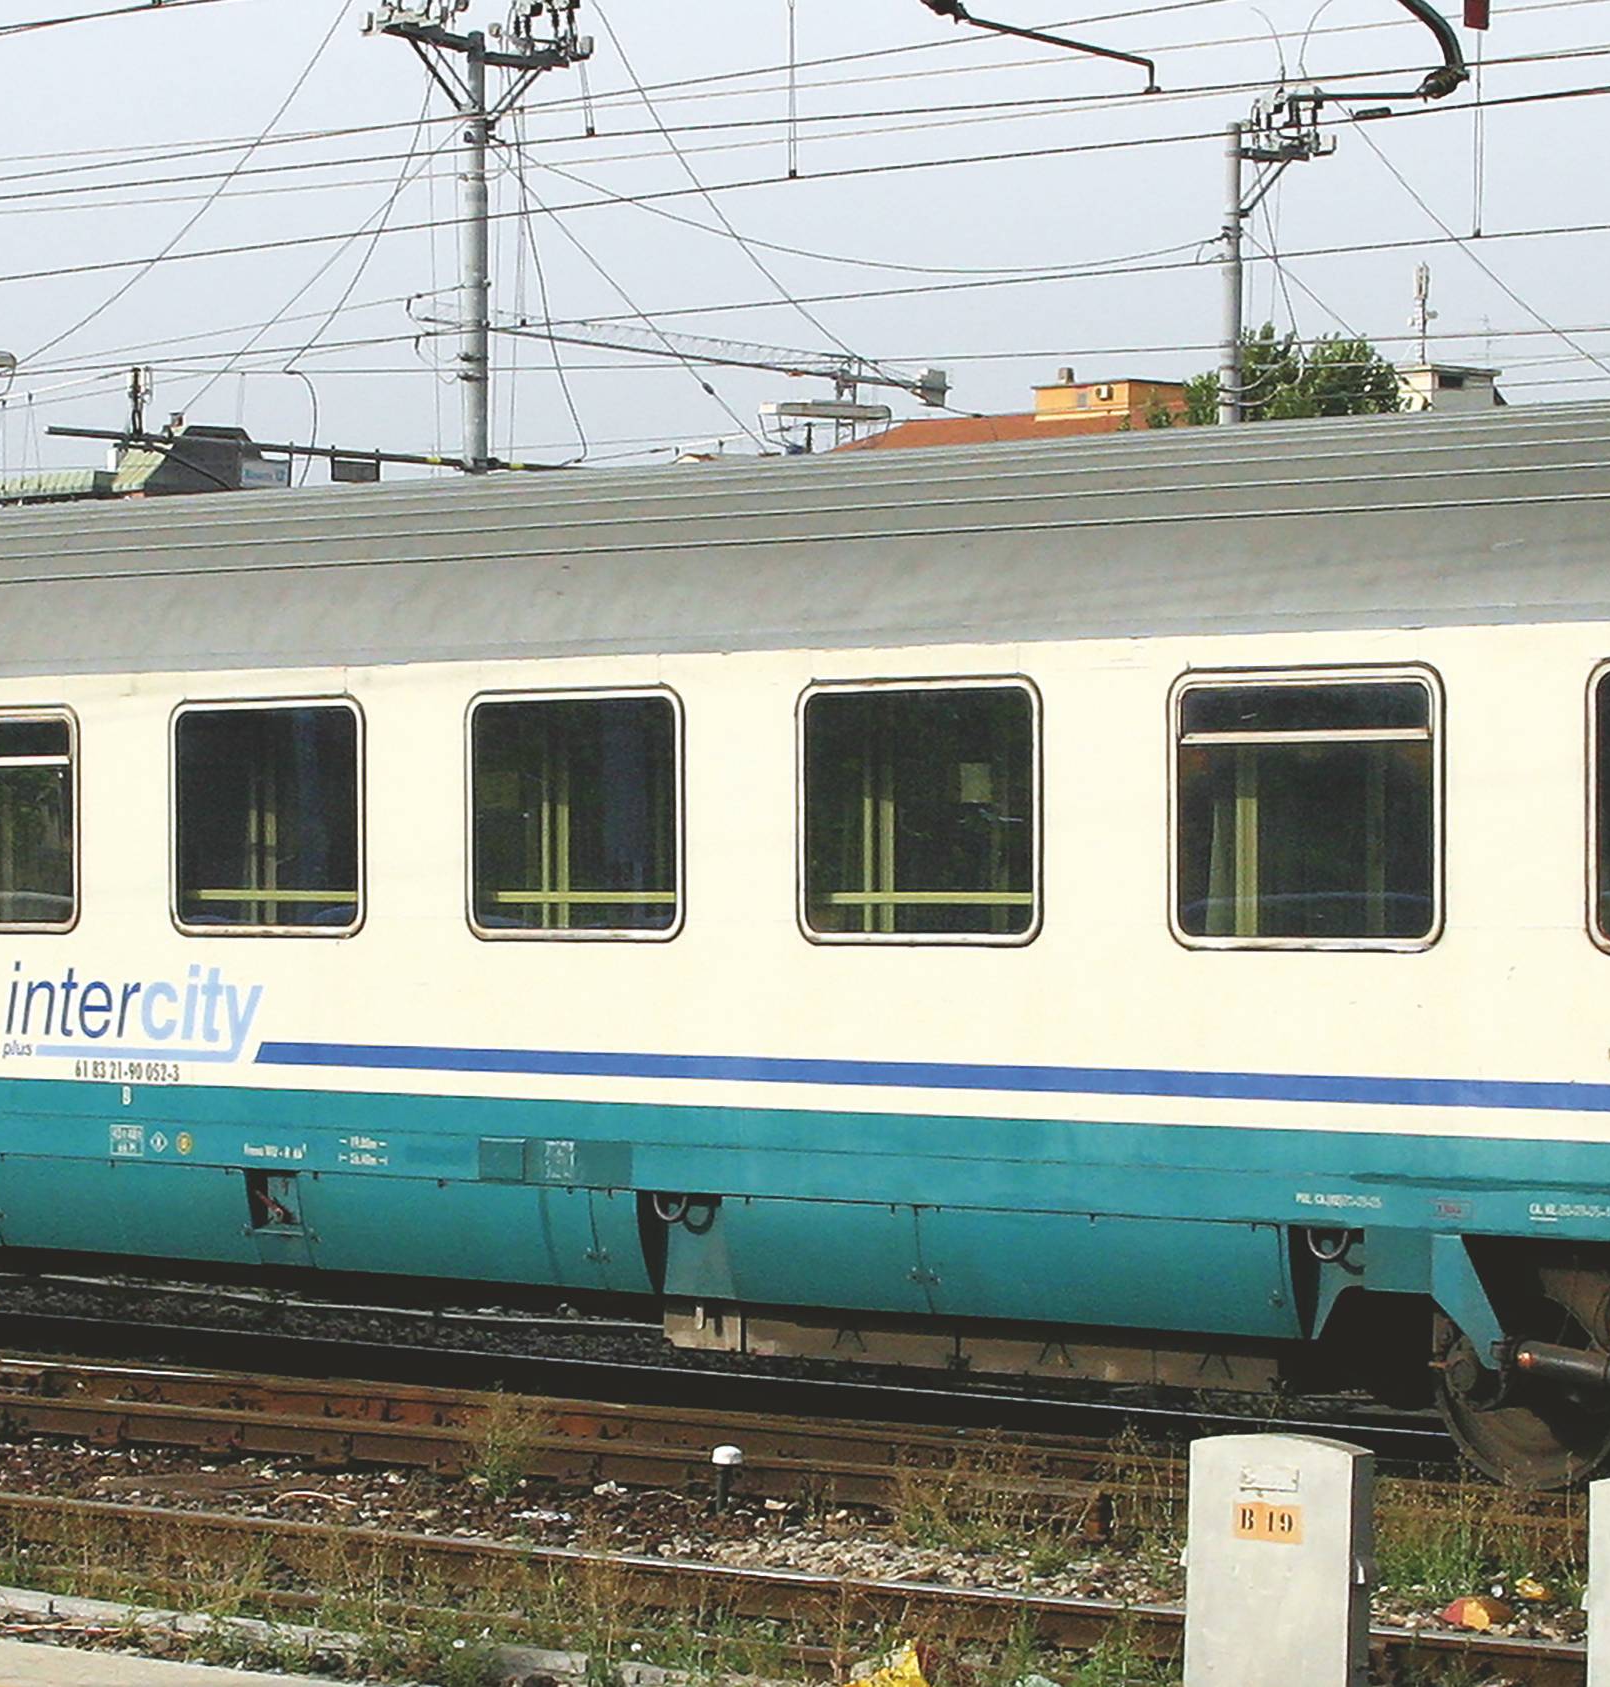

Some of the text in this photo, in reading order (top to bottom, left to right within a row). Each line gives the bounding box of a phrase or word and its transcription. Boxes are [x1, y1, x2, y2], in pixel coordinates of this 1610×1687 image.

[5, 960, 264, 1062] intercity
[2, 1040, 32, 1059] plus
[75, 1059, 88, 1078] 61
[1240, 1508, 1293, 1533] B 19
